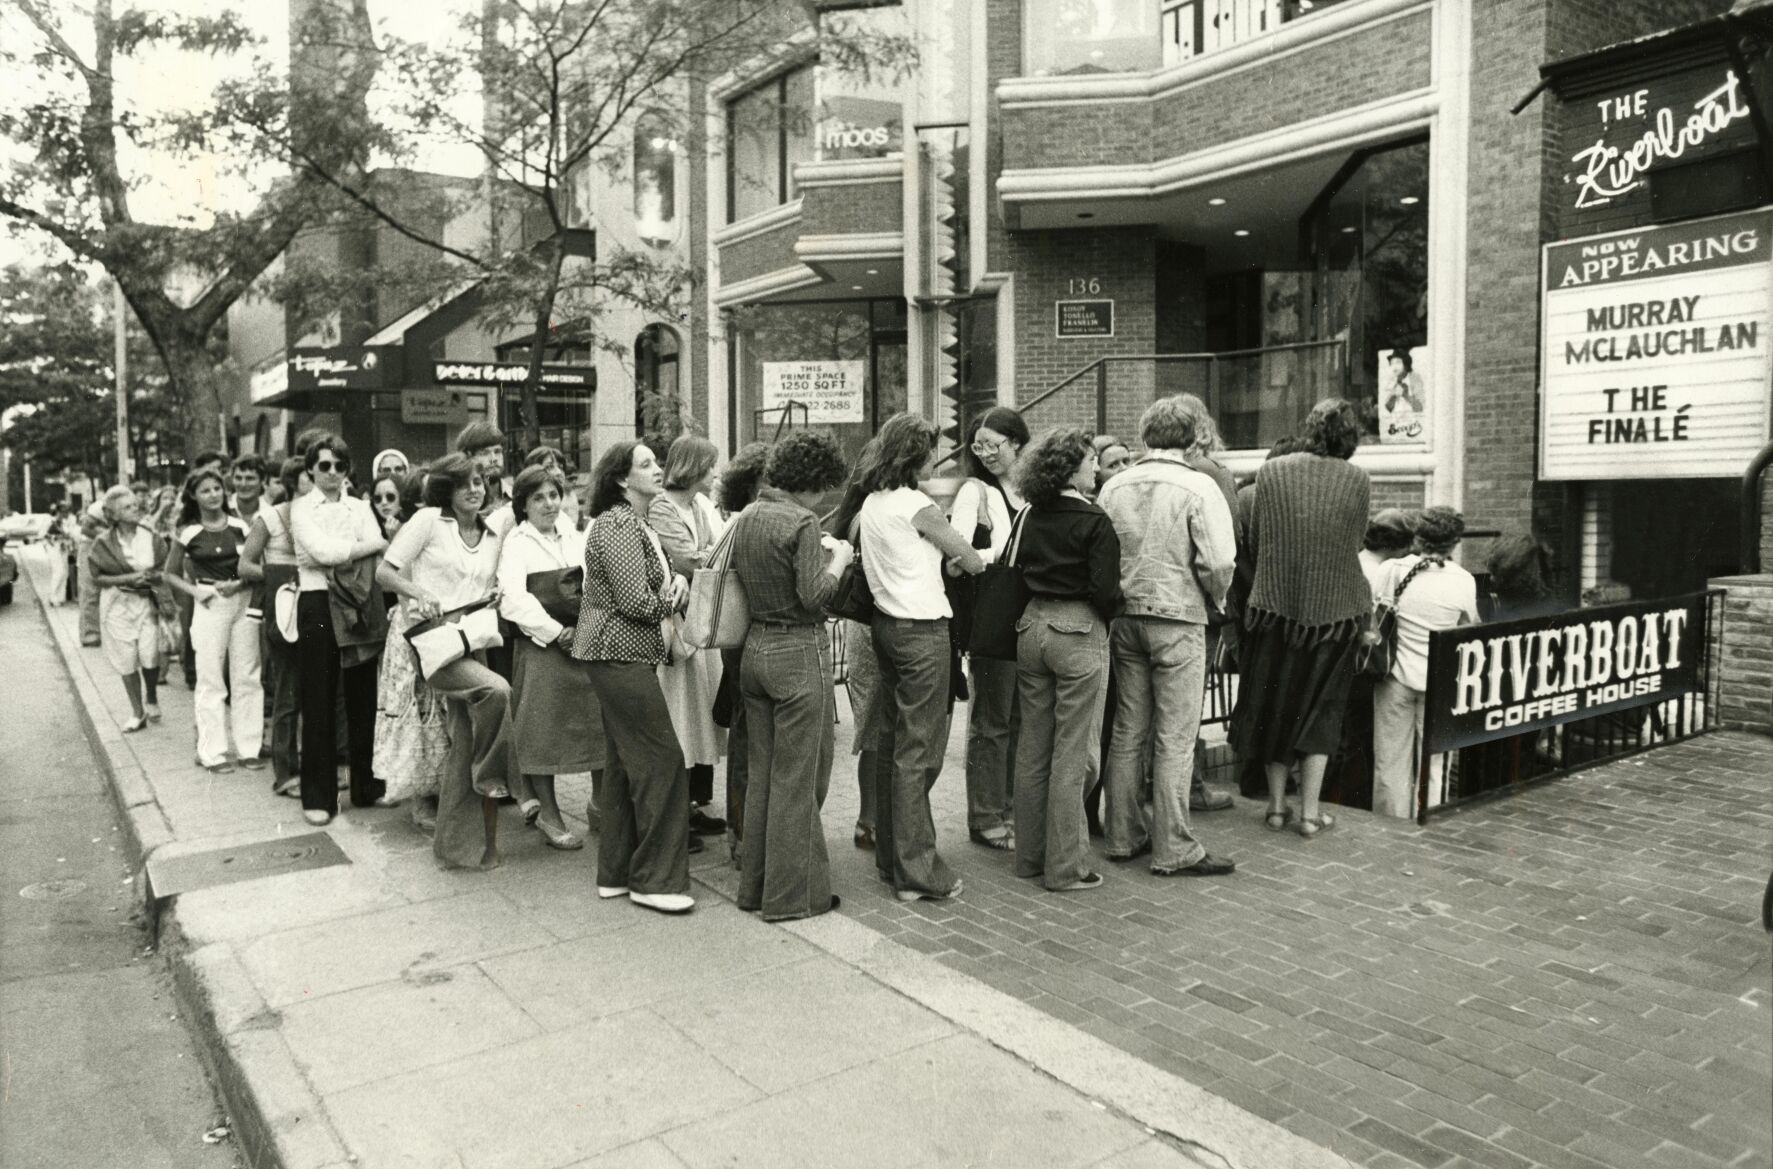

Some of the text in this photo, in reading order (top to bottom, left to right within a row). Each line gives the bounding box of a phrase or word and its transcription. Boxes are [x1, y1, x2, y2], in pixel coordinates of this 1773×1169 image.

[1597, 89, 1649, 123] THE
[1571, 70, 1750, 208] Riverboat
[1559, 230, 1760, 288] APPEARING
[1581, 236, 1641, 258] NOW
[1069, 277, 1101, 295] 136
[1586, 294, 1702, 333] MURRAY
[1565, 320, 1758, 365] MCLAUCHLAN
[780, 372, 847, 381] PRIME SPACE
[781, 381, 809, 390] 1250
[1602, 384, 1668, 414] THE
[1588, 403, 1693, 445] FINALÉ
[1450, 608, 1688, 717] RIVERBOAT
[1485, 675, 1663, 732] COFFEE HOUSE
